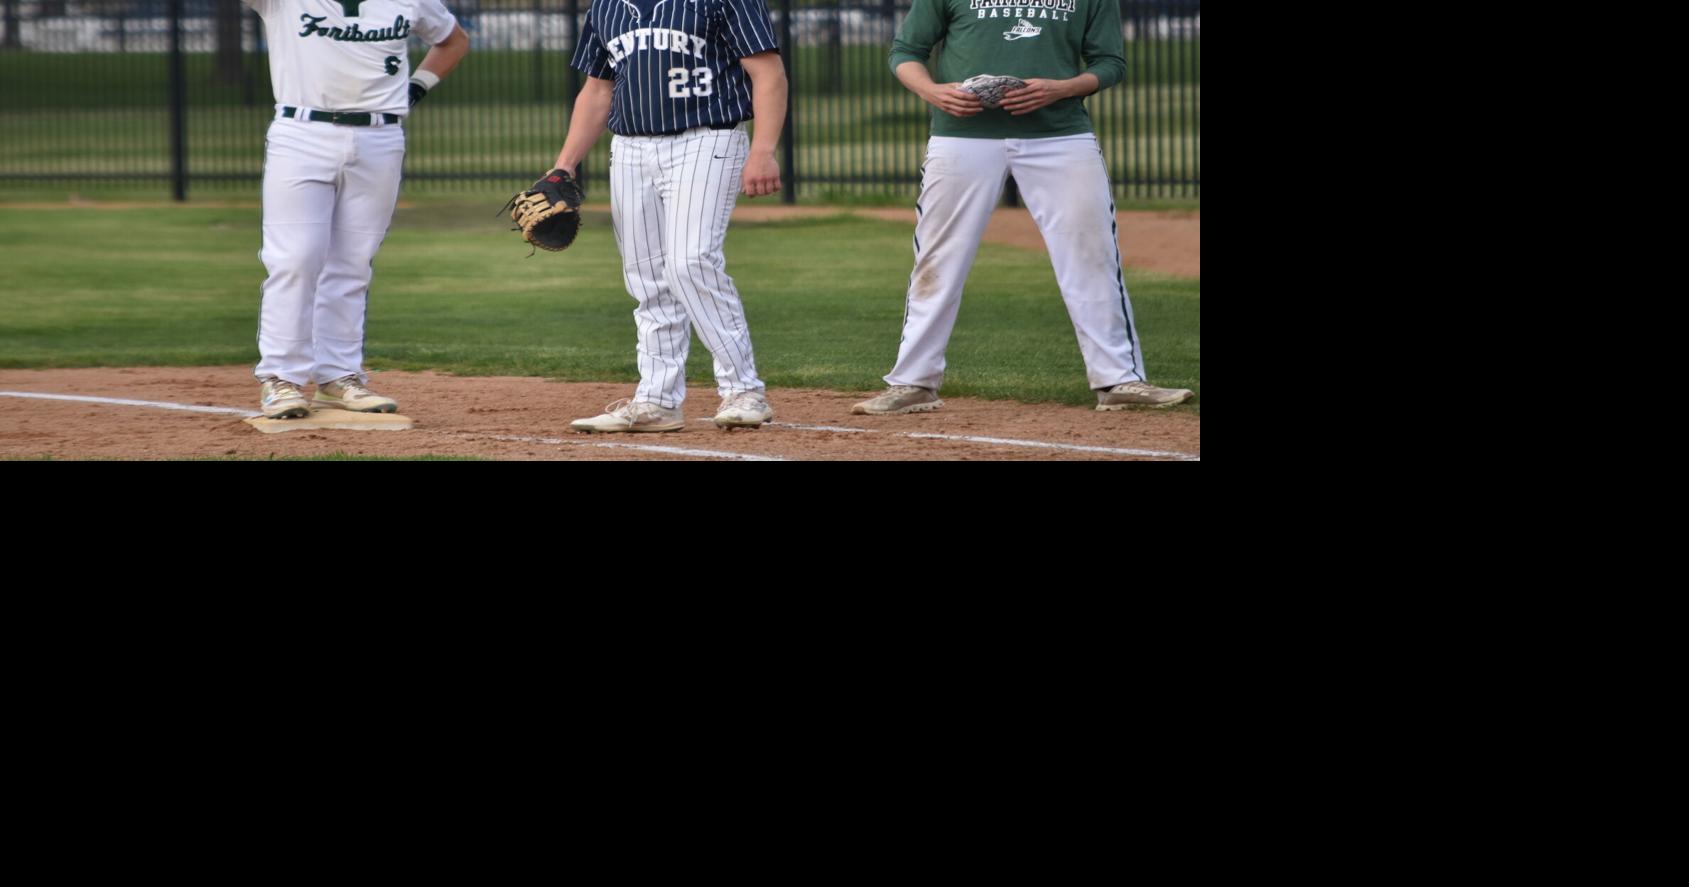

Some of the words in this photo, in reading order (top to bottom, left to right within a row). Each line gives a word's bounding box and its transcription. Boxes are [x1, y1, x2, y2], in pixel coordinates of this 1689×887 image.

[299, 13, 410, 41] Faribault
[977, 8, 1068, 21] BASEBALL
[667, 67, 713, 98] 23
